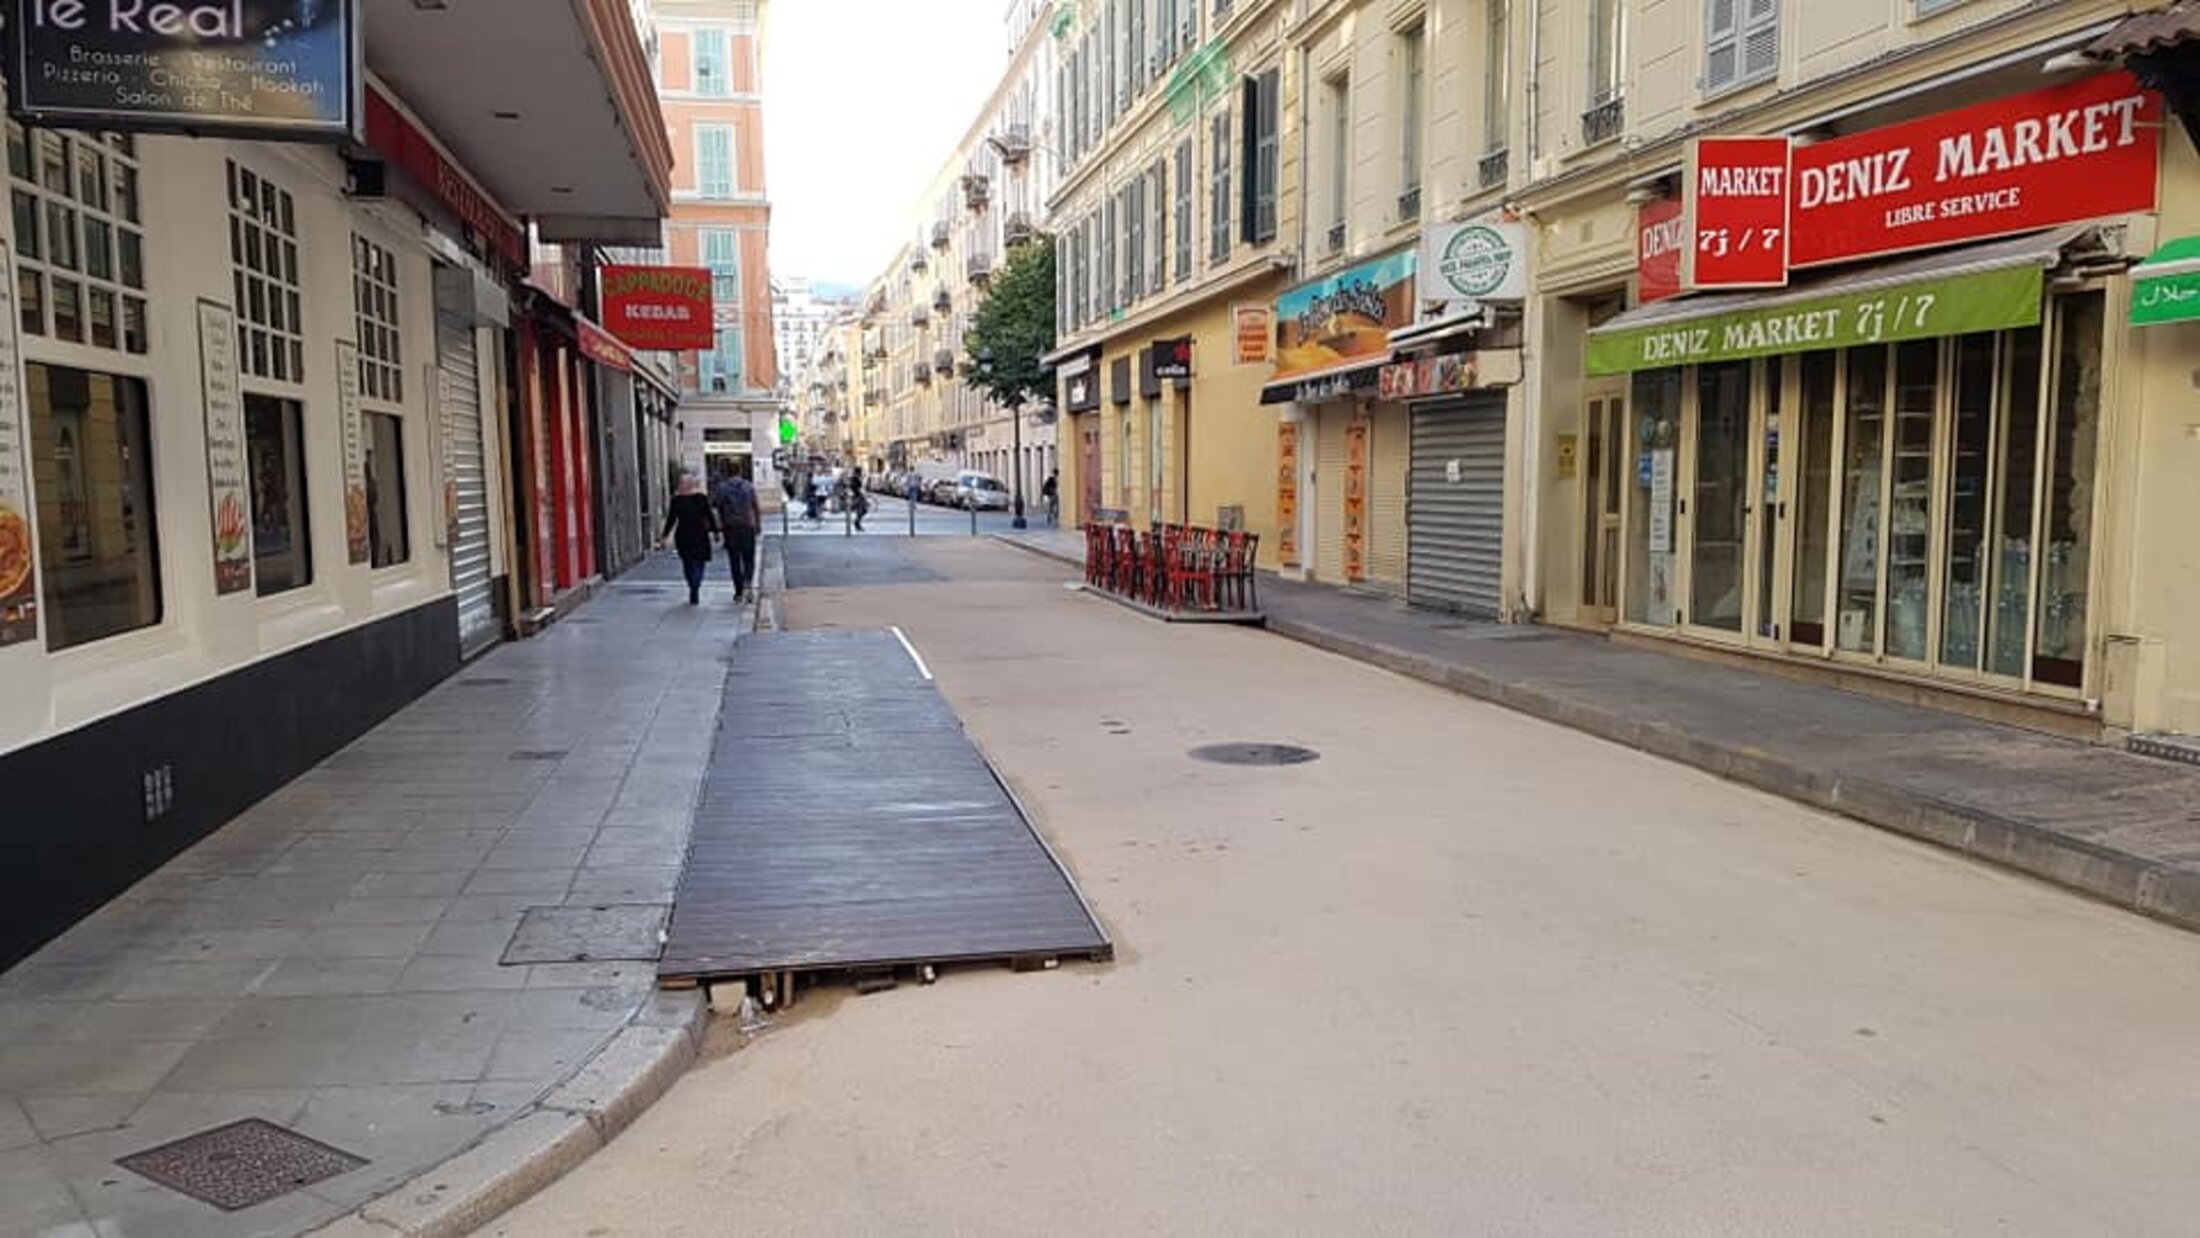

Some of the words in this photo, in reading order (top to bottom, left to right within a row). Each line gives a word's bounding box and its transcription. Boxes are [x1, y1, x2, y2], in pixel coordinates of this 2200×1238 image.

[43, 61, 120, 84] Pizzeria
[70, 44, 160, 67] Brasserie
[189, 51, 297, 75] Restaurant
[115, 86, 171, 105] Salon
[182, 92, 203, 108] de
[1799, 147, 1912, 209] DENIZ
[1934, 95, 2145, 182] MARKET
[1700, 166, 1783, 197] MARKET
[1885, 201, 1936, 228] LIBRE
[1939, 187, 2021, 219] SERVICE
[1699, 228, 1729, 256] 7j
[1762, 228, 1781, 249] 7
[625, 304, 691, 320] KEBAB
[1643, 329, 1709, 361] DENIZ
[1722, 308, 1841, 351] MARKET
[1855, 301, 1886, 342] 7j
[1914, 294, 1936, 328] 7
